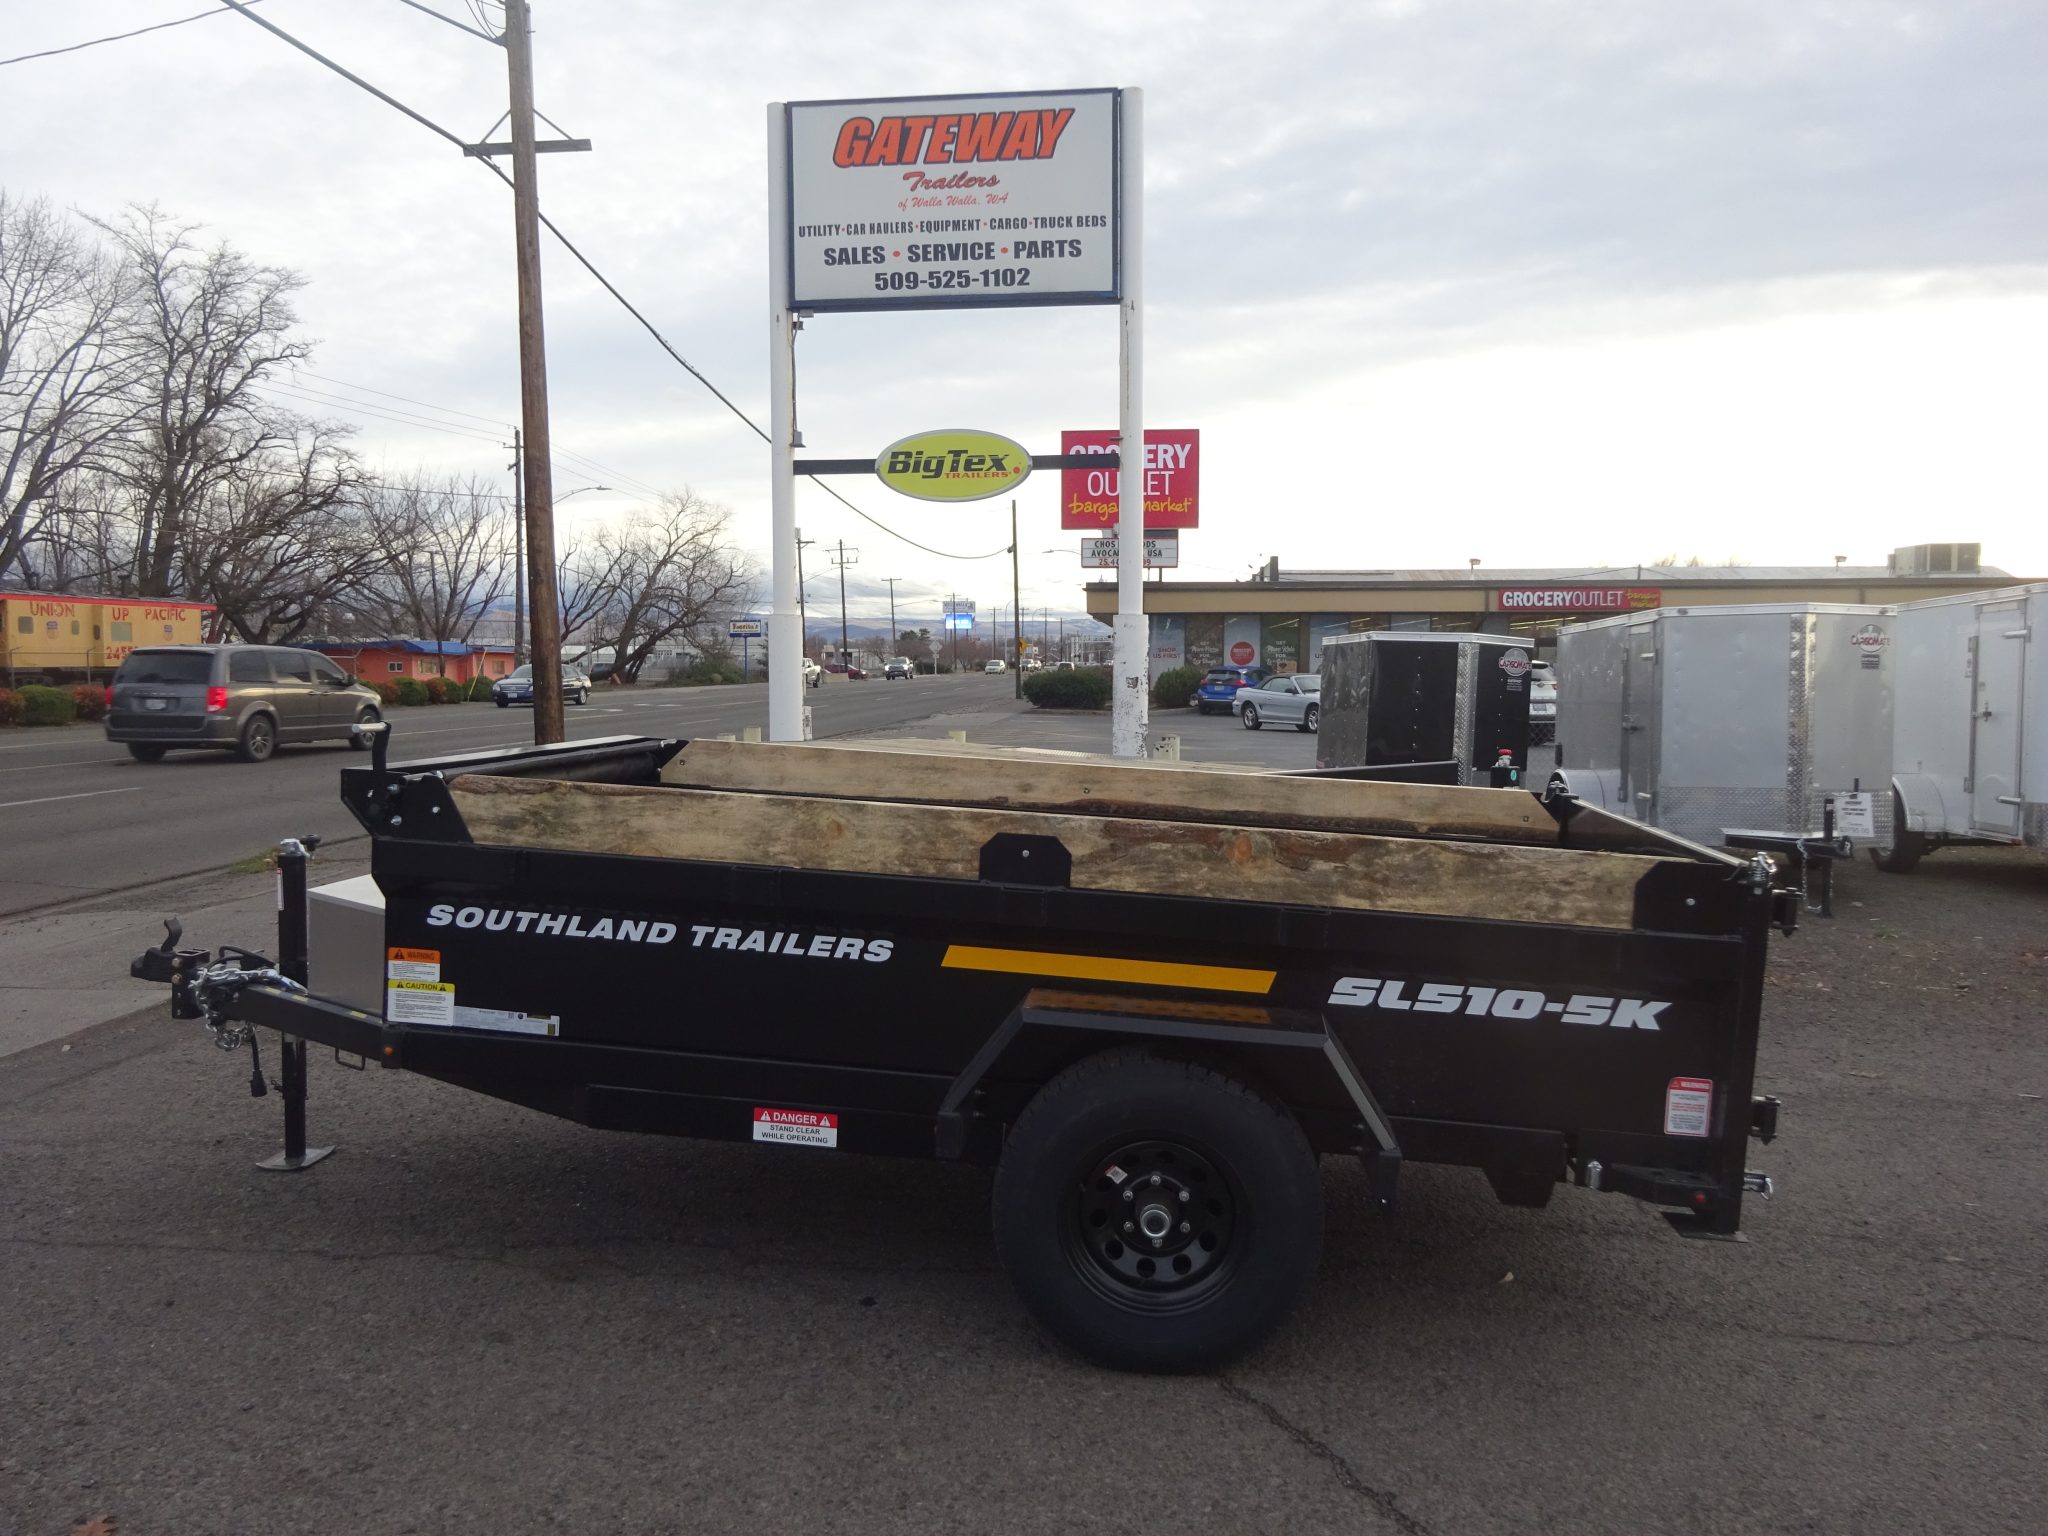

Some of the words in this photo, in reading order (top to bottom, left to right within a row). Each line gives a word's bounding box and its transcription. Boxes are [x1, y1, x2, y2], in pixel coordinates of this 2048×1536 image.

[832, 108, 1076, 169] GATEWAY
[902, 170, 1000, 192] Trailers
[898, 198, 908, 212] of
[911, 196, 942, 208] Walla
[985, 192, 1008, 205] WA
[798, 224, 841, 238] UTILITY
[846, 223, 866, 236] CAR
[869, 221, 914, 235] HAULERS
[919, 219, 981, 234] EQUIPMENT
[989, 217, 1028, 231] CARGO
[1033, 216, 1073, 229] TRUCK
[1076, 215, 1107, 228] BEDS
[823, 245, 886, 266] SALES
[907, 242, 996, 263] SERVICE
[1013, 238, 1082, 259] PARTS
[874, 267, 1031, 291] 509-525-1102
[943, 471, 1009, 479] TRAILERS
[1087, 470, 1175, 497] OUET
[1147, 549, 1163, 557] USA
[30, 601, 75, 618] UNION
[111, 607, 130, 621] UP
[145, 607, 187, 622] PACIFIC
[426, 904, 677, 945] SOUTHLAND
[690, 925, 895, 963] TRAILERS
[405, 982, 438, 991] CAUTION
[773, 1112, 817, 1125] DANGER
[761, 1131, 785, 1140] WHILE
[786, 1133, 828, 1144] OPERATING
[770, 1124, 794, 1133] STAND
[796, 1126, 821, 1135] CLEAR
